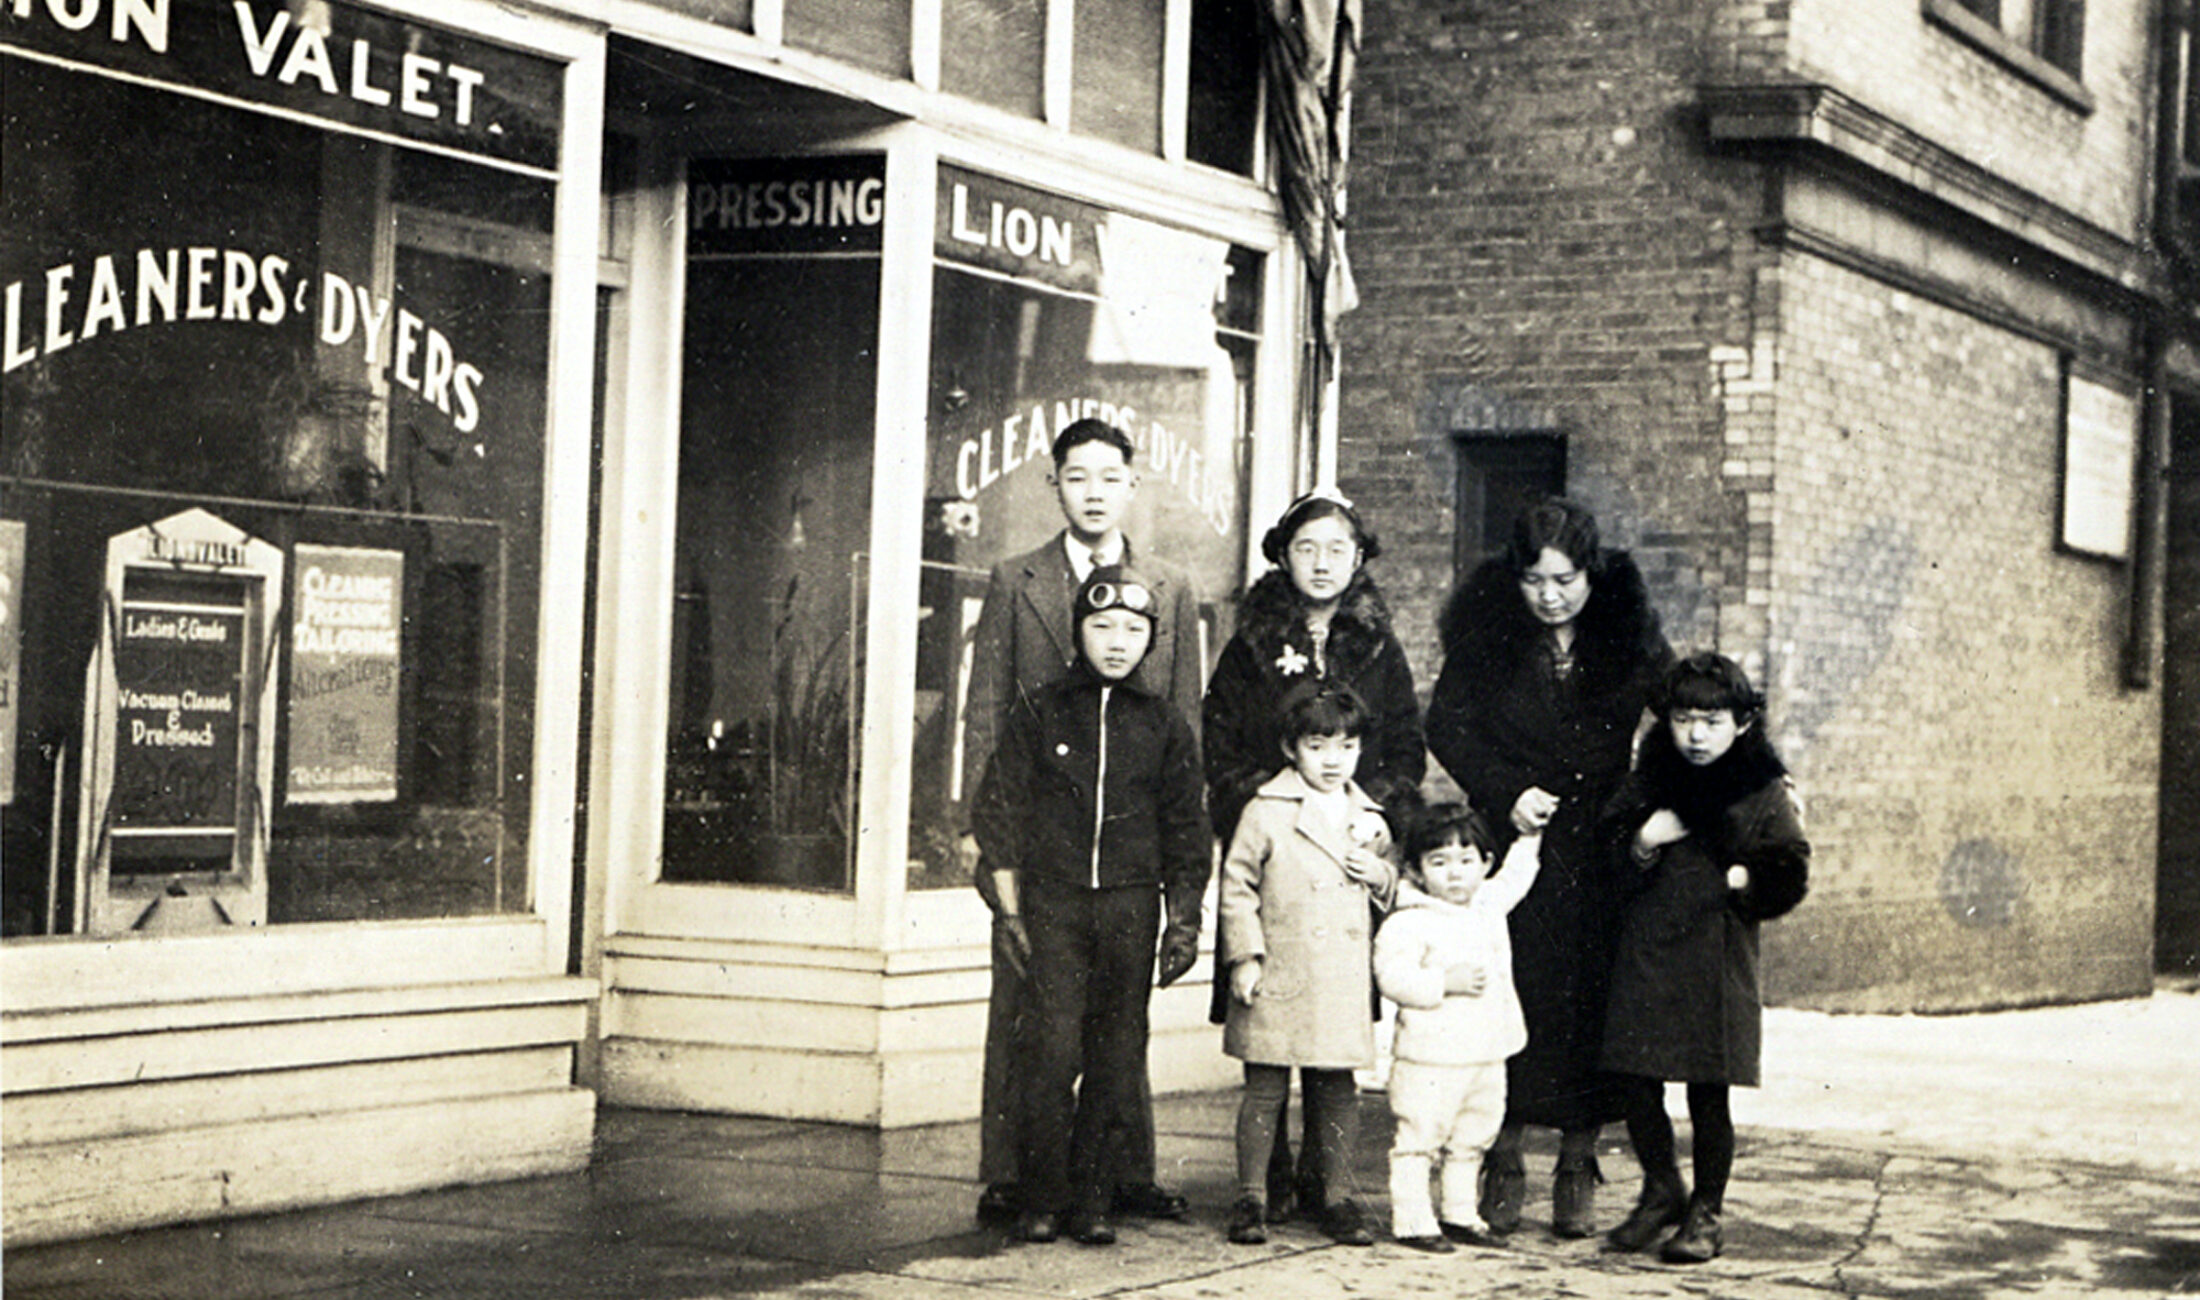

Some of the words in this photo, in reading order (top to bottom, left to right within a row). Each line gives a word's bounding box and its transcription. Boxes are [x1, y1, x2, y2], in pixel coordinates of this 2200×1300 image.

[693, 178, 883, 230] PRESSING
[952, 184, 1072, 266] LION
[3, 247, 289, 374] LEANERS
[956, 398, 1138, 500] CLEANS
